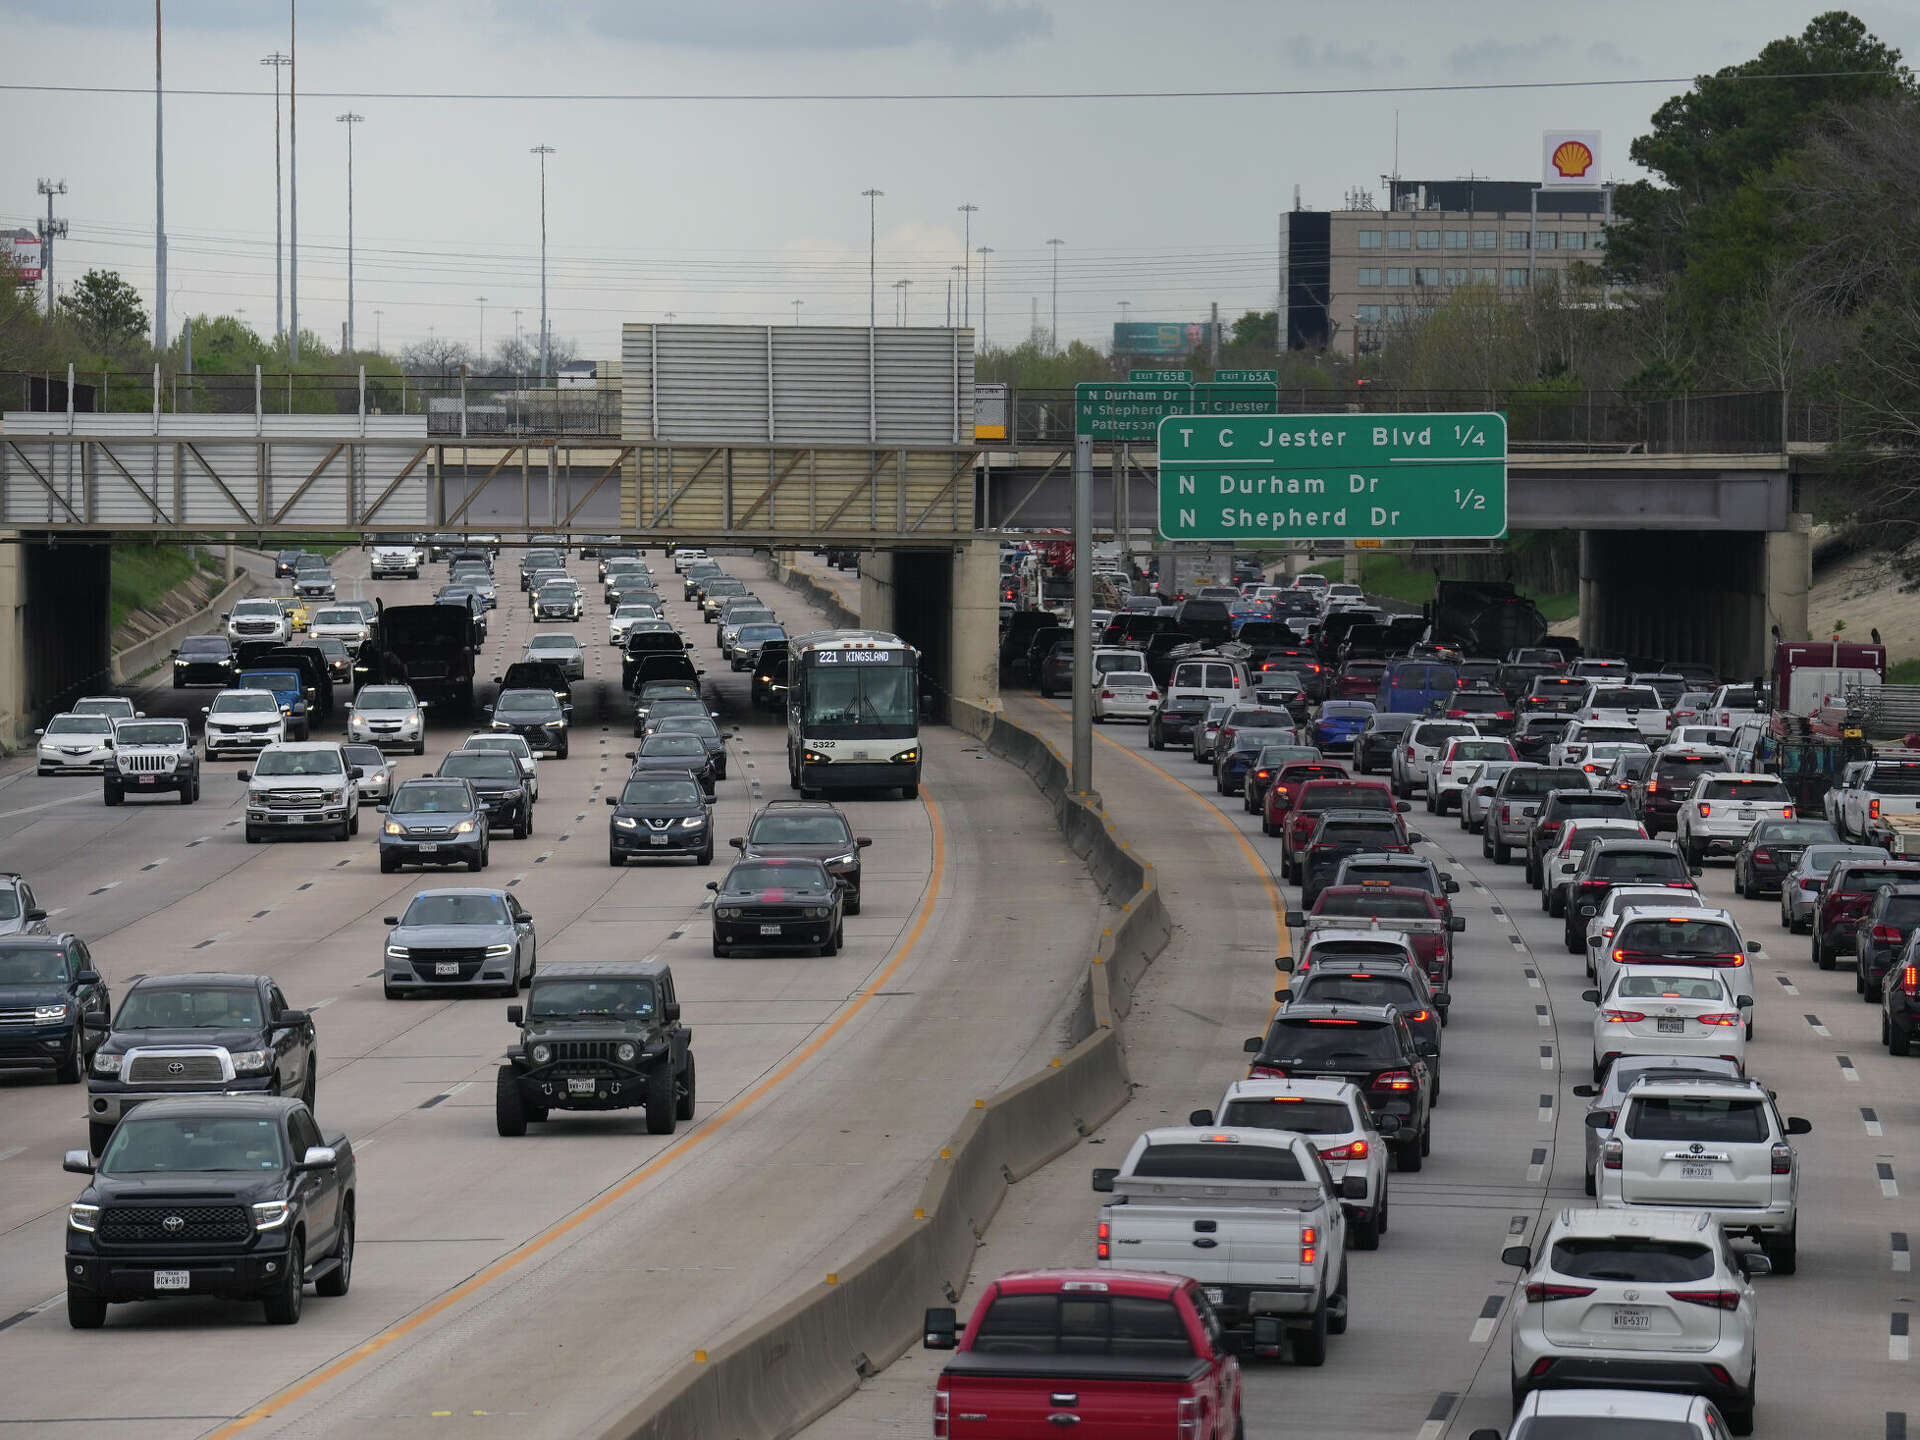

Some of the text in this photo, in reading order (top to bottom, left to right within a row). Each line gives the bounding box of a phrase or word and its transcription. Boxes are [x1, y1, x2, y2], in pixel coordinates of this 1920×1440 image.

[1135, 371, 1185, 380] EXIT 765B
[1240, 372, 1271, 381] 765A
[1088, 390, 1179, 400] N Durham Dr
[1083, 405, 1184, 417] N Shepherd Dr
[1200, 401, 1270, 411] T C Jester
[1091, 420, 1156, 430] Patterson
[1179, 428, 1194, 448] T
[1218, 428, 1235, 448] C
[1258, 428, 1347, 448] Jester
[1372, 427, 1431, 446] Blvd
[1179, 474, 1379, 494] N Durham Dr
[1179, 507, 1400, 531] N Shepherd Dr
[819, 651, 889, 663] 221 KINGSLAND
[812, 741, 836, 749] 5322
